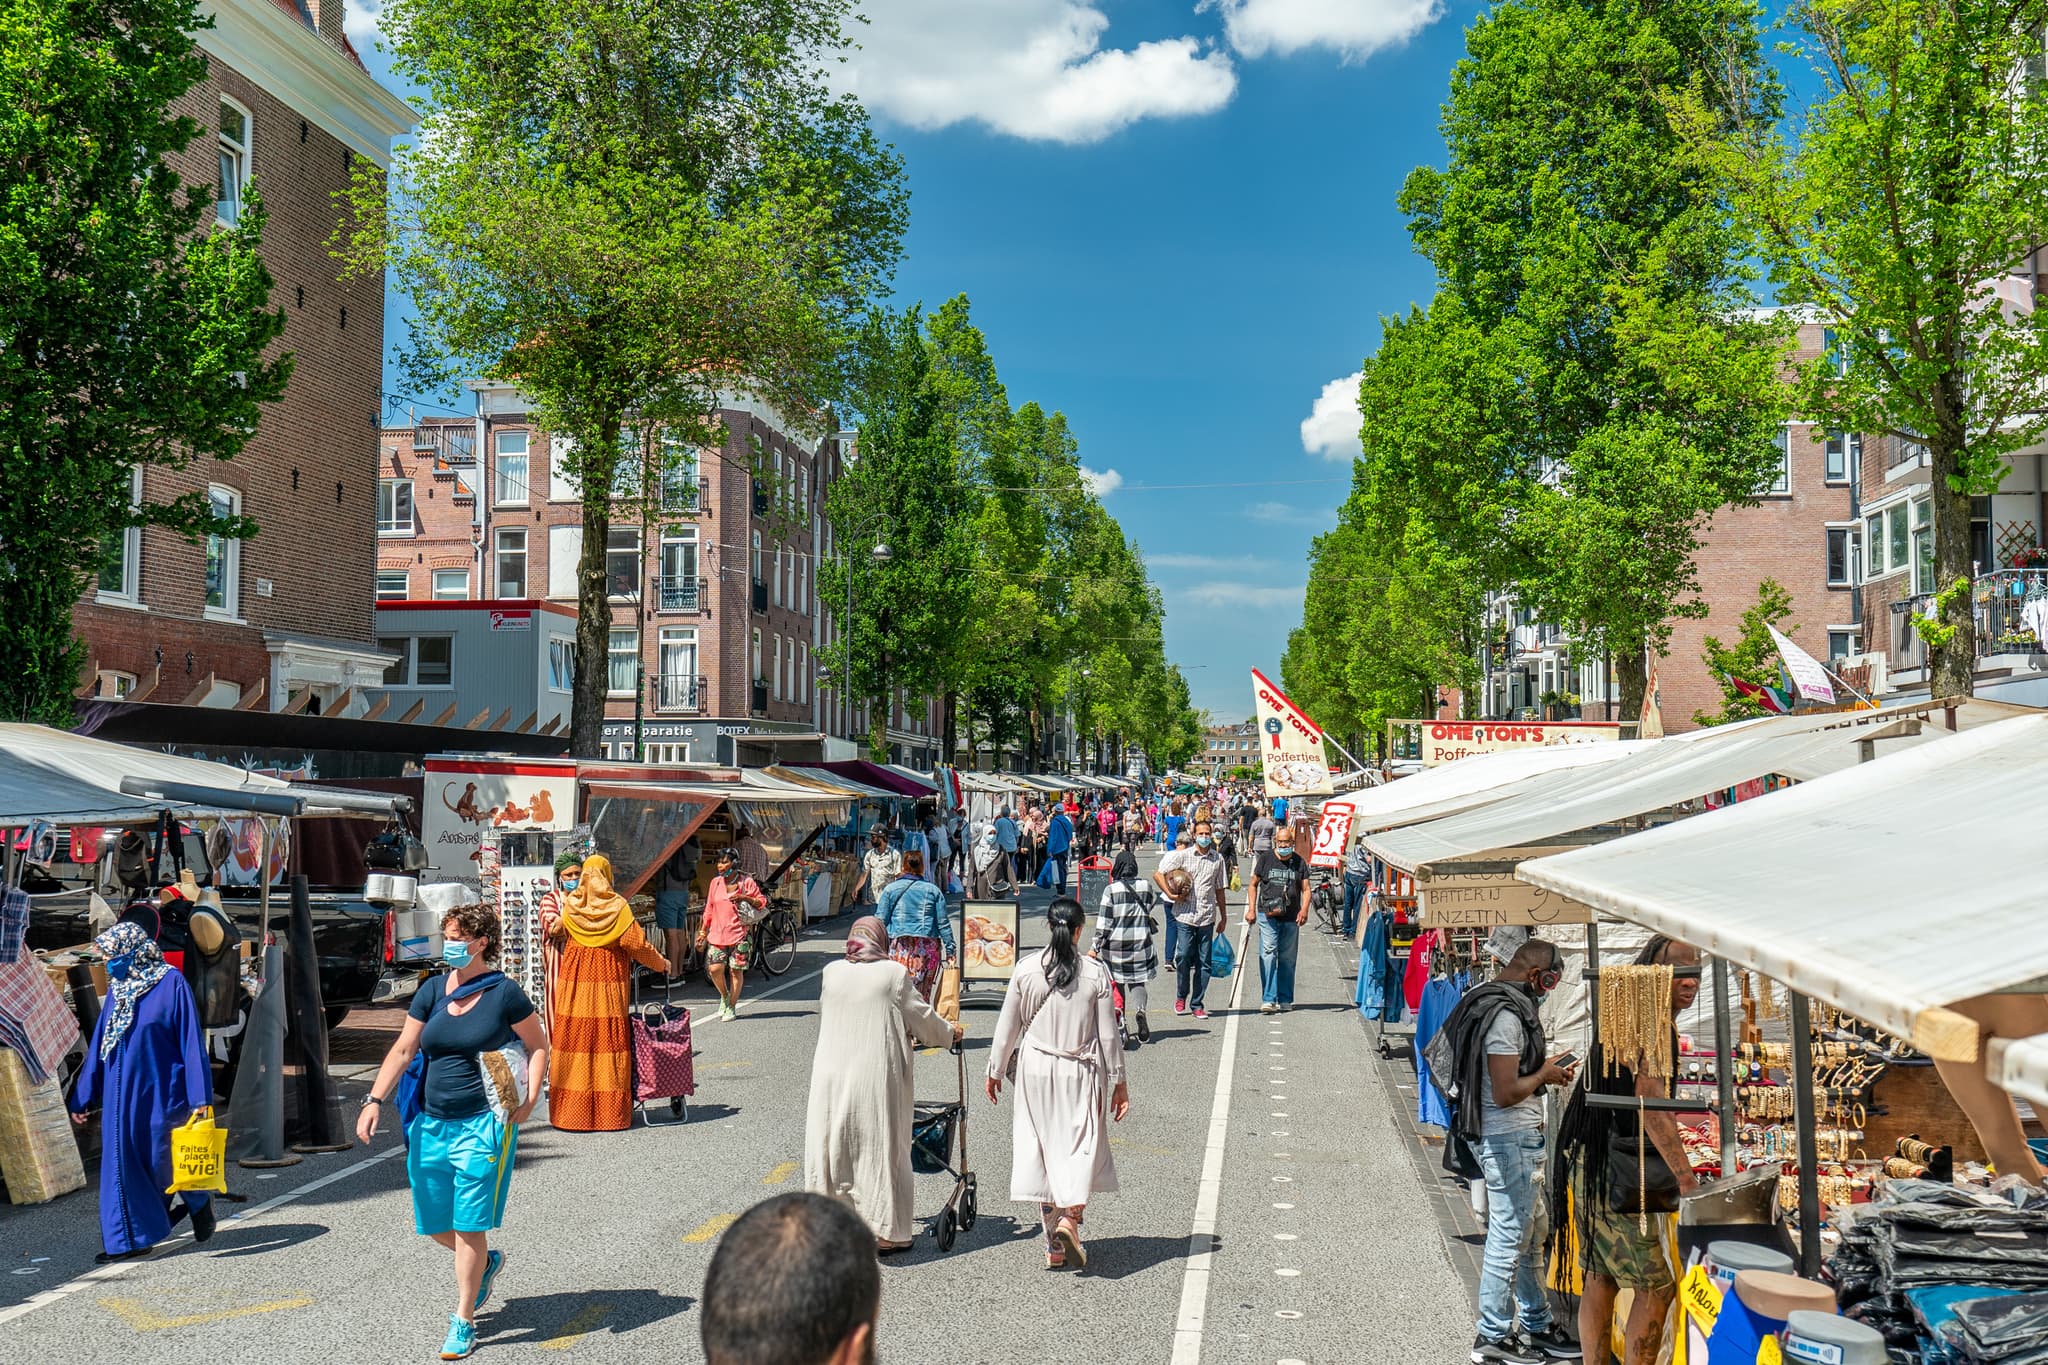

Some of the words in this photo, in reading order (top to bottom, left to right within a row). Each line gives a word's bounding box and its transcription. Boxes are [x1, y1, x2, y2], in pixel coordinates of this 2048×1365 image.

[1259, 689, 1285, 713] OME
[1286, 712, 1320, 745] TOM'S
[624, 725, 693, 739] Rparatie
[716, 725, 751, 737] BOTEX
[1431, 724, 1474, 741] OME
[1484, 726, 1545, 743] TOM'S
[1267, 752, 1321, 764] Poffertjes
[438, 830, 480, 845] André
[180, 1144, 209, 1153] Faites
[184, 1152, 210, 1162] place
